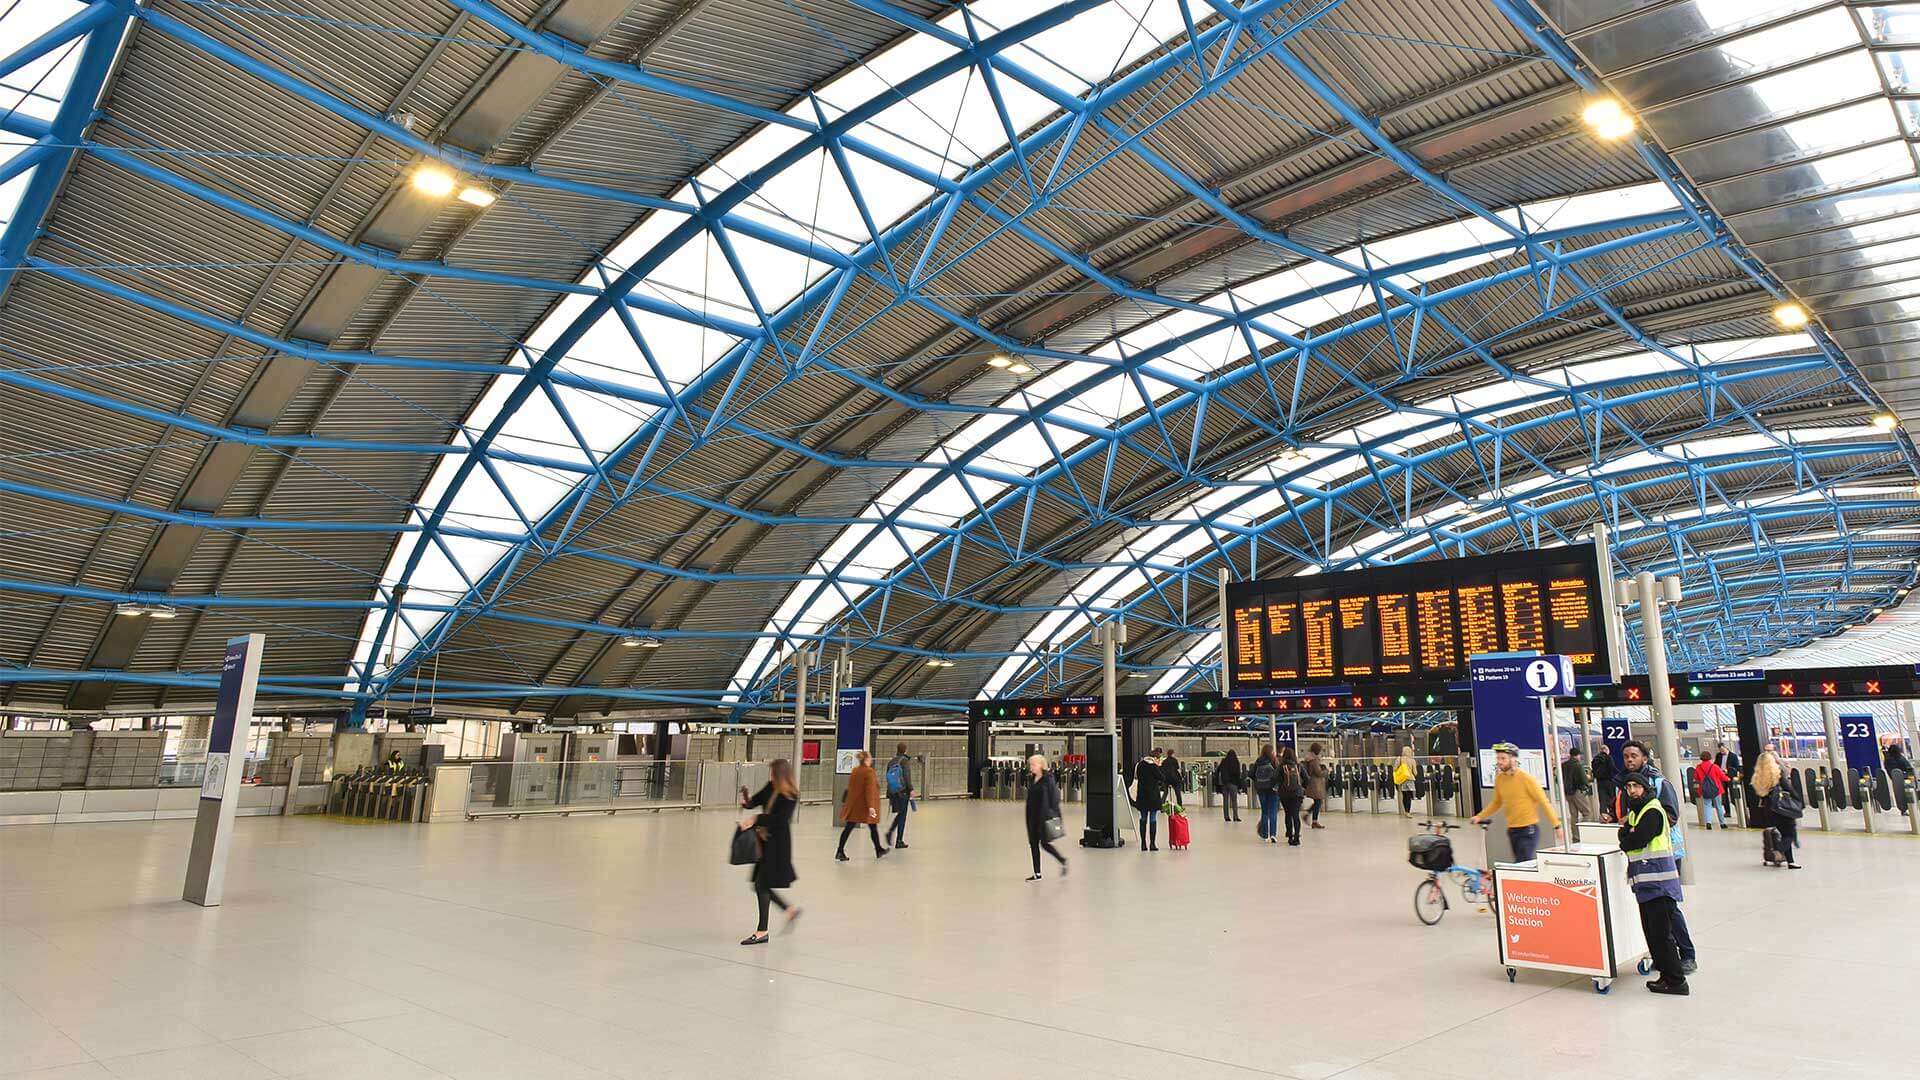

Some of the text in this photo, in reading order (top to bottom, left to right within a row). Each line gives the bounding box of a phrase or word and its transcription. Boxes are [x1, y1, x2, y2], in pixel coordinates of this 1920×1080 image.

[1279, 730, 1292, 741] 21
[1606, 726, 1625, 740] 22
[1846, 723, 1870, 738] 23
[1507, 892, 1560, 906] Welcome to
[1507, 904, 1551, 917] Waterloo
[1508, 915, 1543, 928] Station
